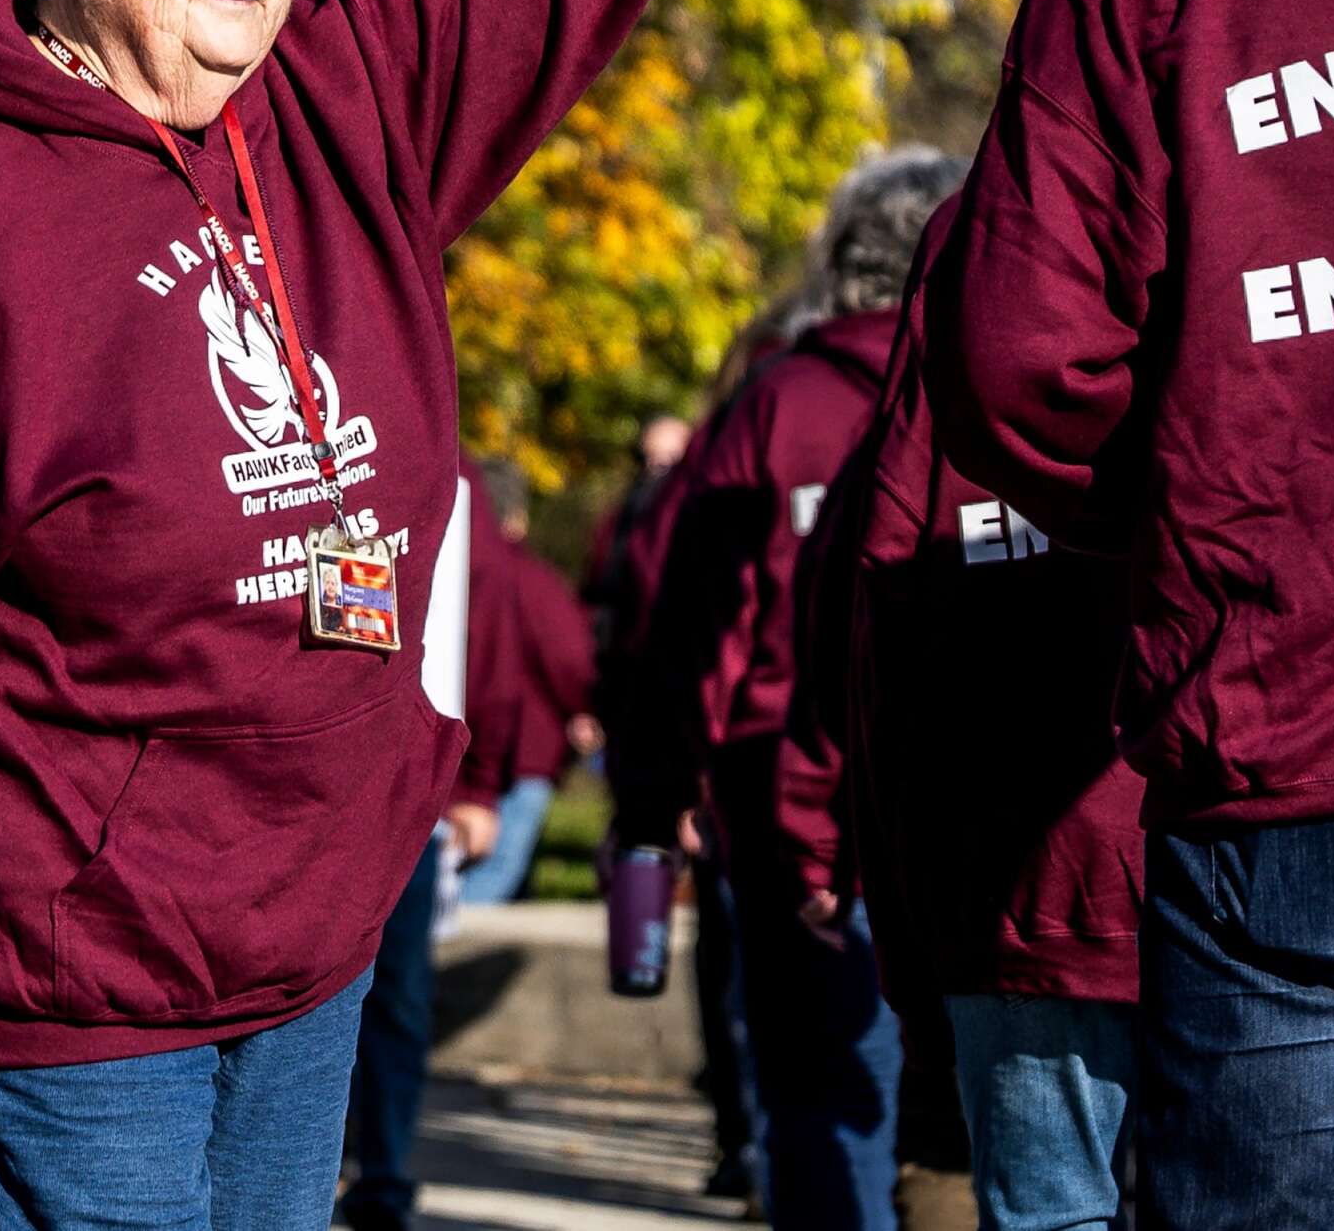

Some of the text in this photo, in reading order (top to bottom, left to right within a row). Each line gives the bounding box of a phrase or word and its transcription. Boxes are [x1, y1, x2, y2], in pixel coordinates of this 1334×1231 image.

[48, 38, 72, 64] HACC
[207, 215, 260, 300] HACC HACC
[242, 494, 268, 517] Our
[346, 508, 380, 540] IS
